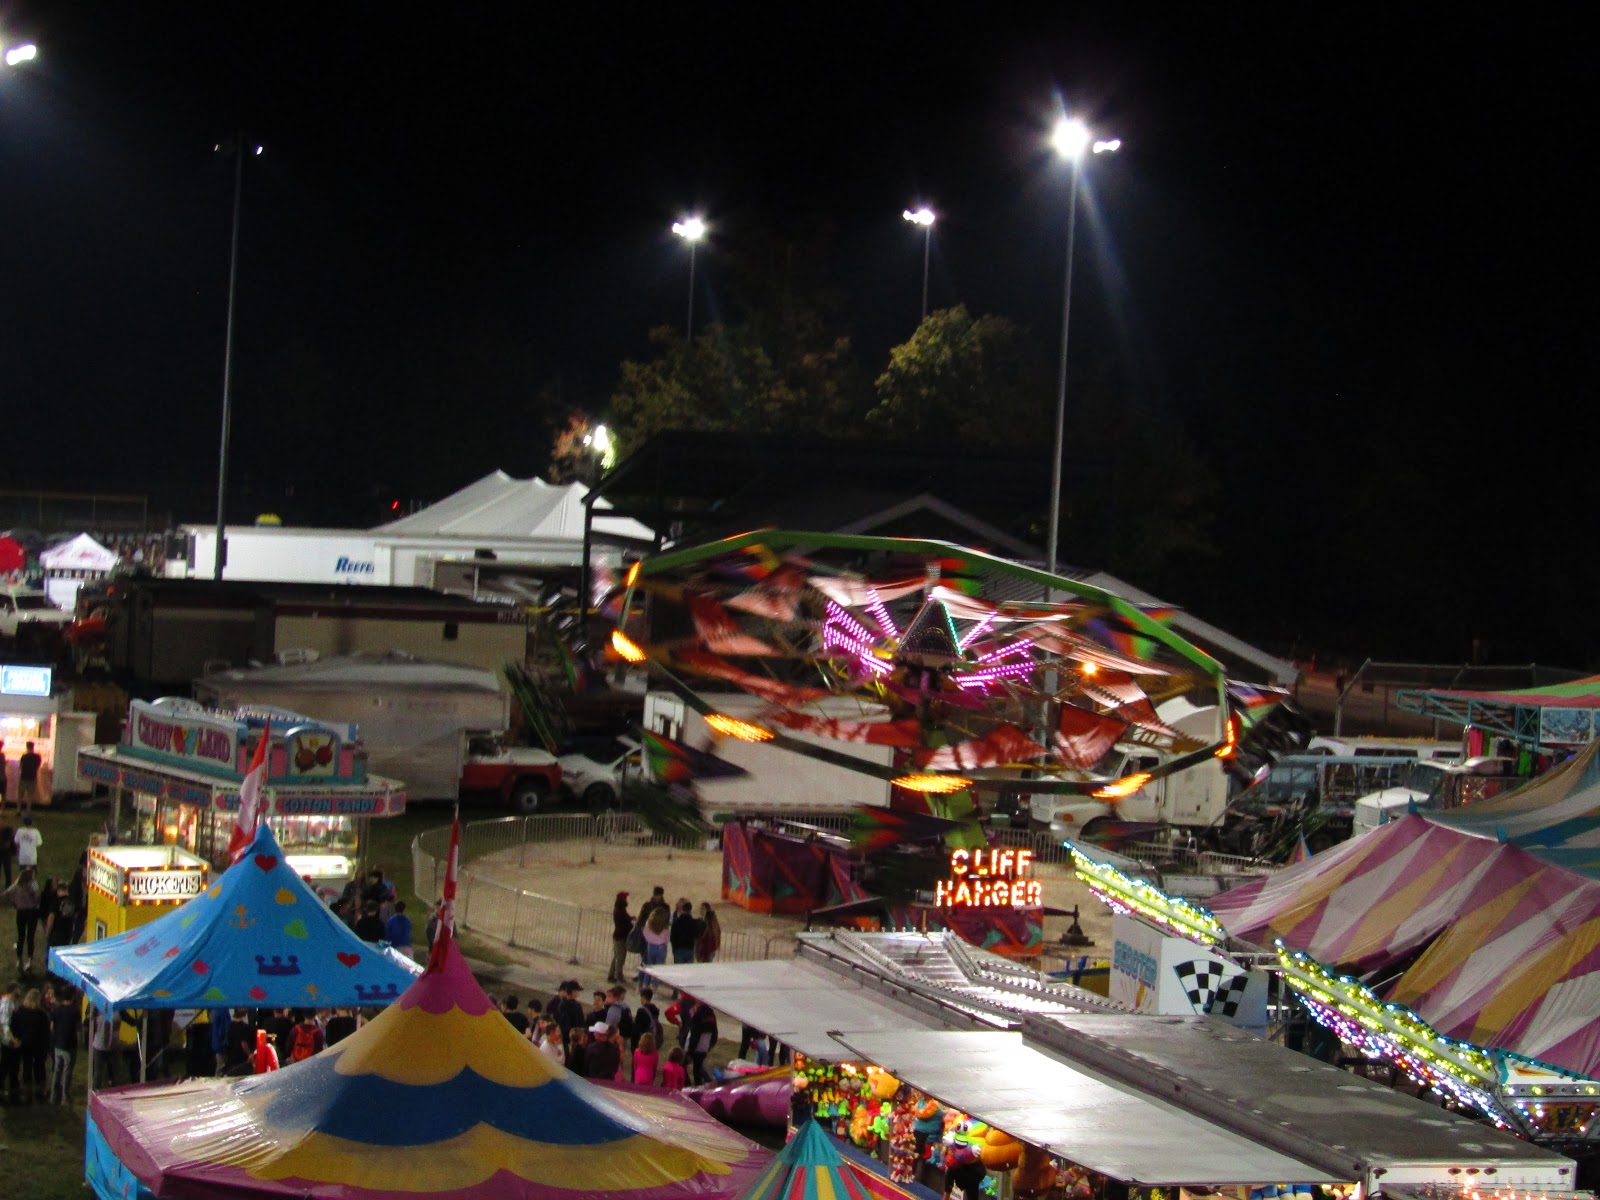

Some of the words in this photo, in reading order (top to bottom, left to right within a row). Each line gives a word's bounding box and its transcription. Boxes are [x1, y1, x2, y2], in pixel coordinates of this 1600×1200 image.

[138, 712, 174, 752] CANDY
[196, 726, 231, 763] LAND
[282, 797, 332, 814] COTTON
[336, 798, 377, 814] CANDY
[951, 848, 1032, 875] CLIFF
[131, 874, 201, 895] TICKETS
[936, 880, 1042, 907] HANGER
